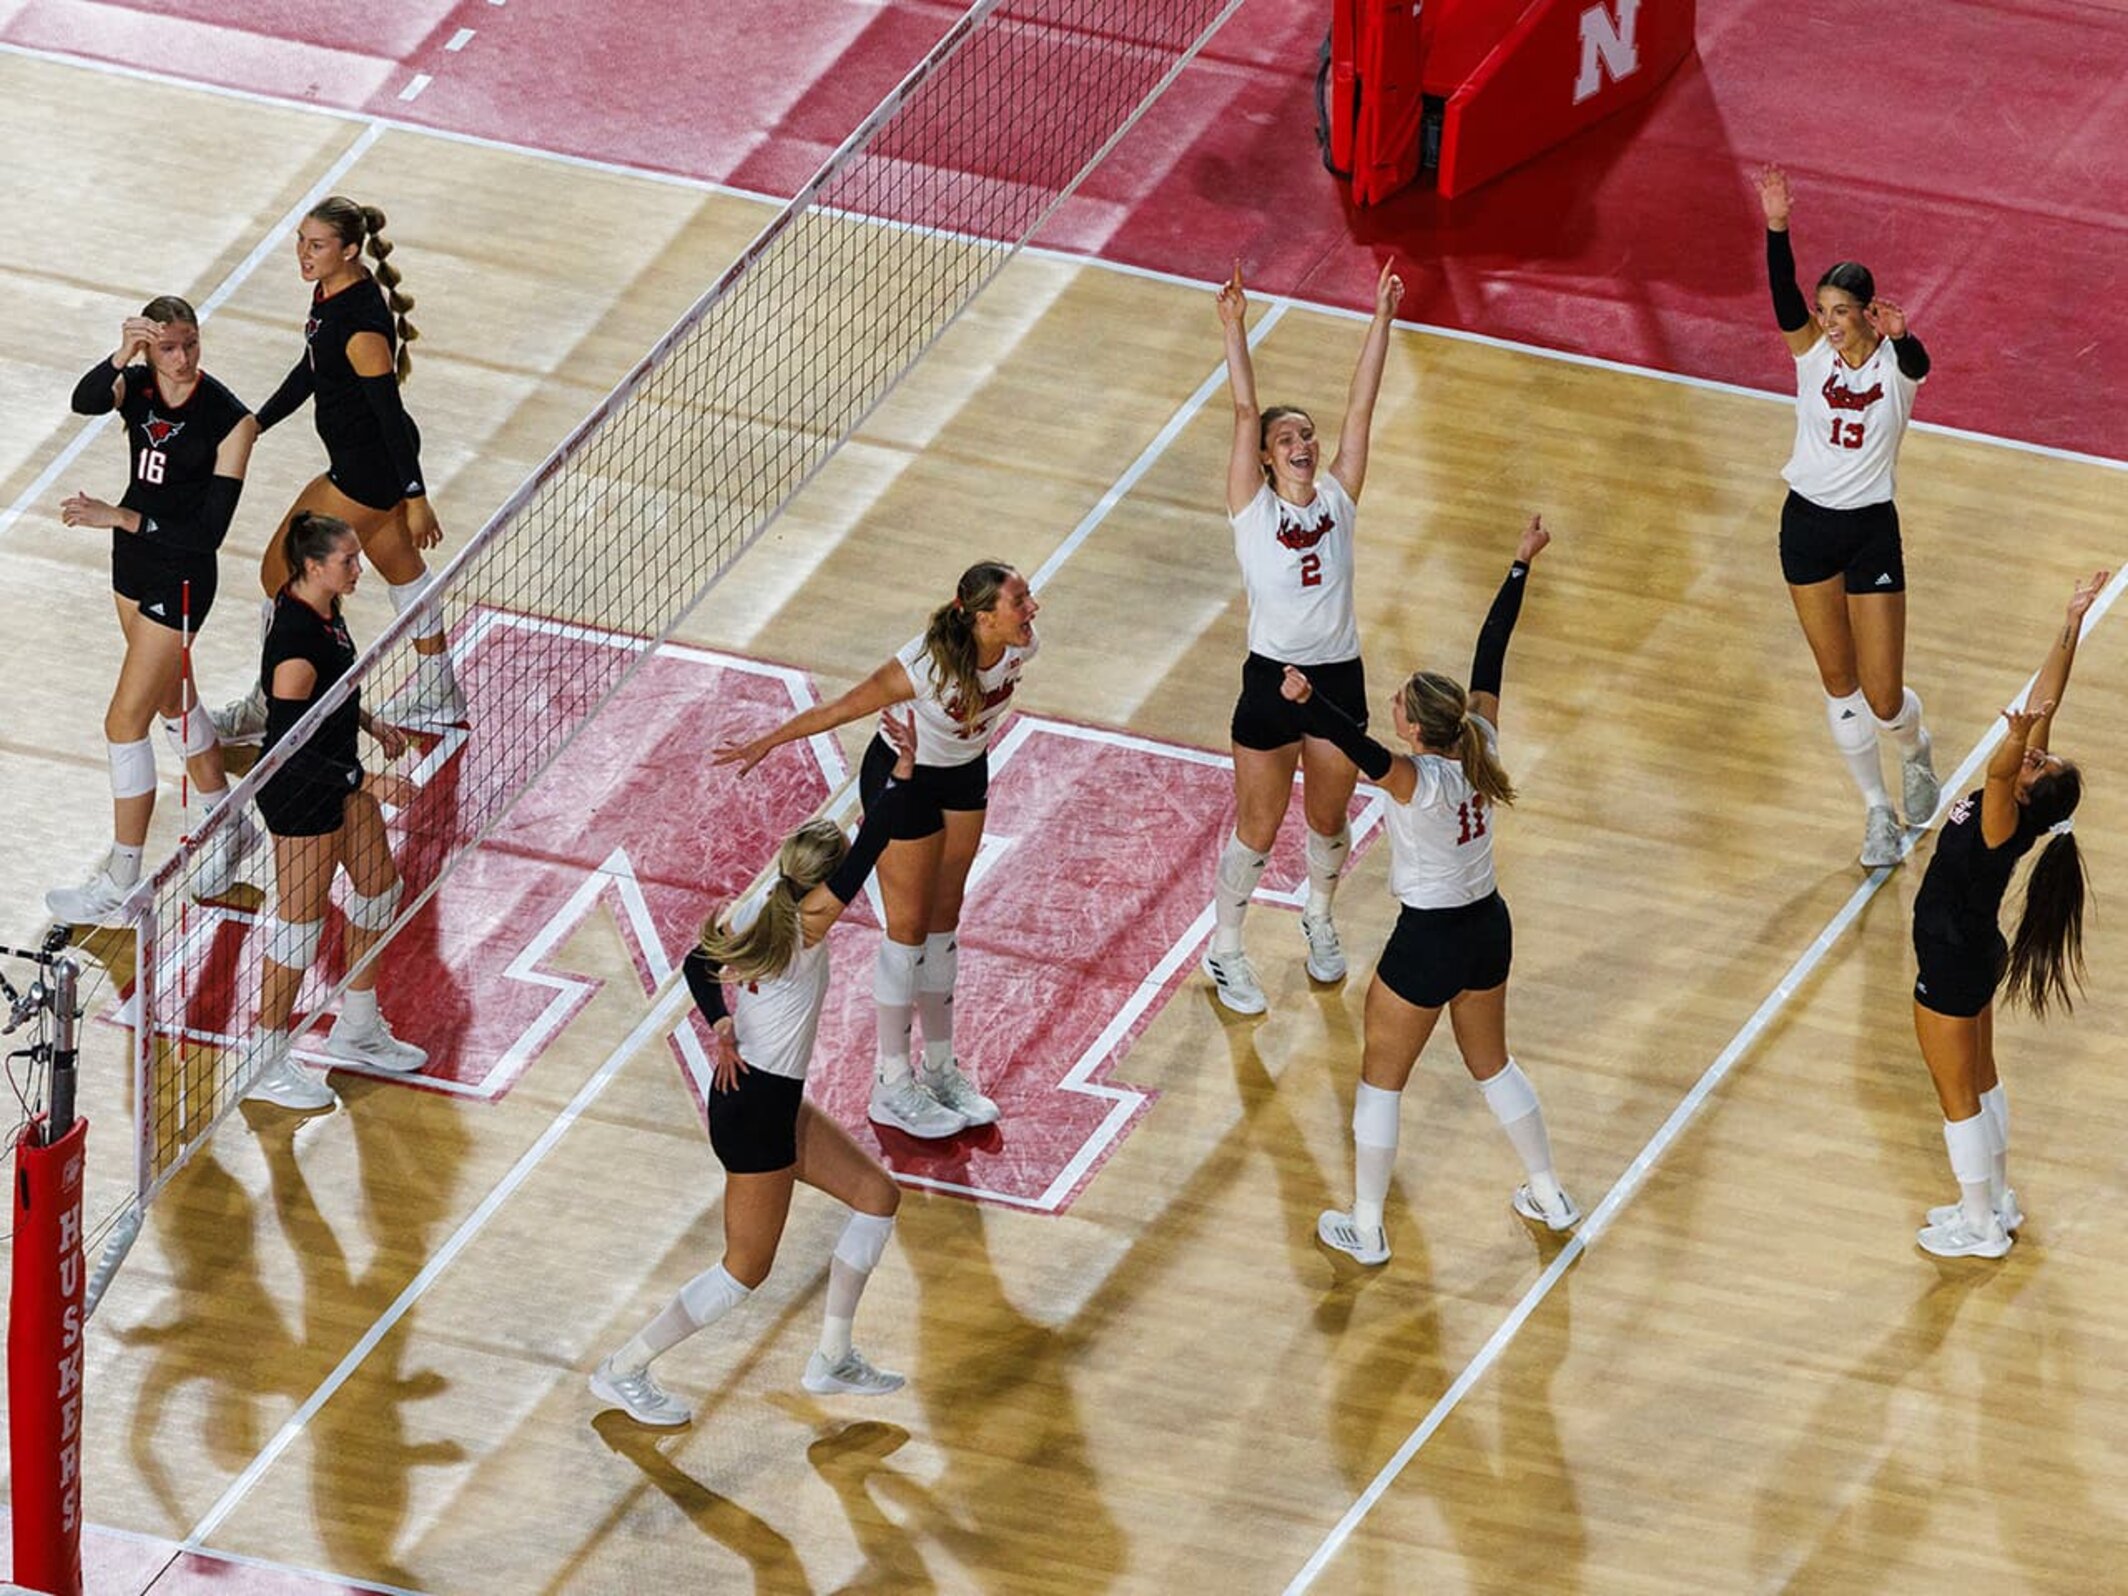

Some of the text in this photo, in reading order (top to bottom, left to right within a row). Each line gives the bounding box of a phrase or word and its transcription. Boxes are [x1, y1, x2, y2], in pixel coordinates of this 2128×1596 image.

[1572, 0, 1642, 106] N
[1828, 416, 1866, 450] 13
[138, 447, 167, 485] 16
[1300, 551, 1323, 588] 2
[1456, 793, 1487, 846] 11
[58, 1201, 81, 1533] HUSKERS
